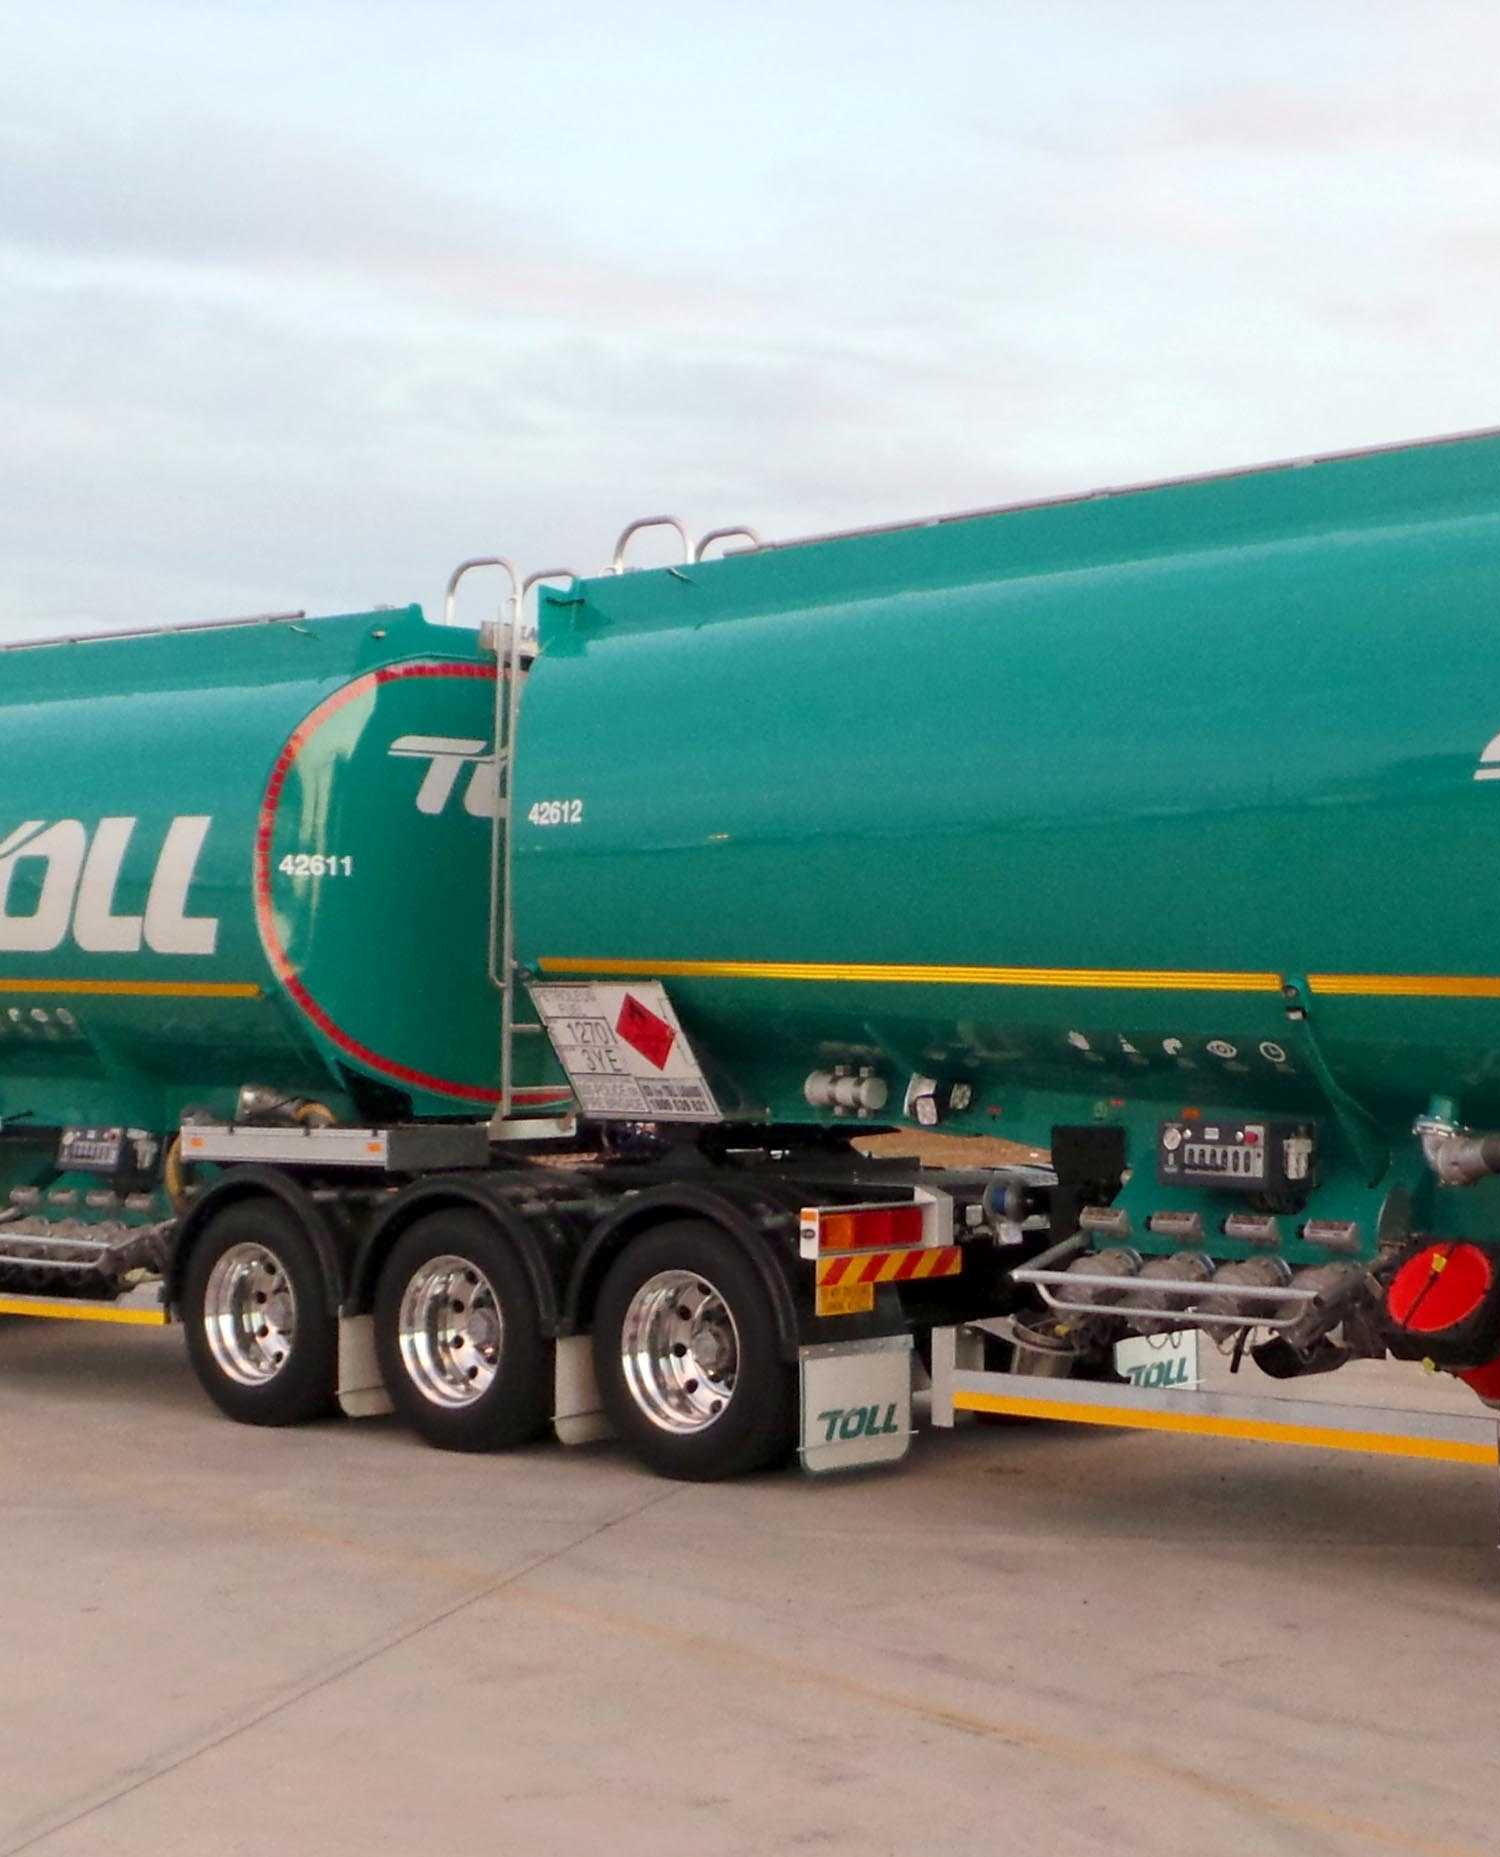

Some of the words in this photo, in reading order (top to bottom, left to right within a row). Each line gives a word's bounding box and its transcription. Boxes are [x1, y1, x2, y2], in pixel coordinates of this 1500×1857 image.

[529, 799, 583, 825] 42612
[279, 854, 353, 877] 42611
[0, 815, 219, 955] OLL
[1126, 1356, 1189, 1388] TOLL
[816, 1402, 899, 1442] TOLL
